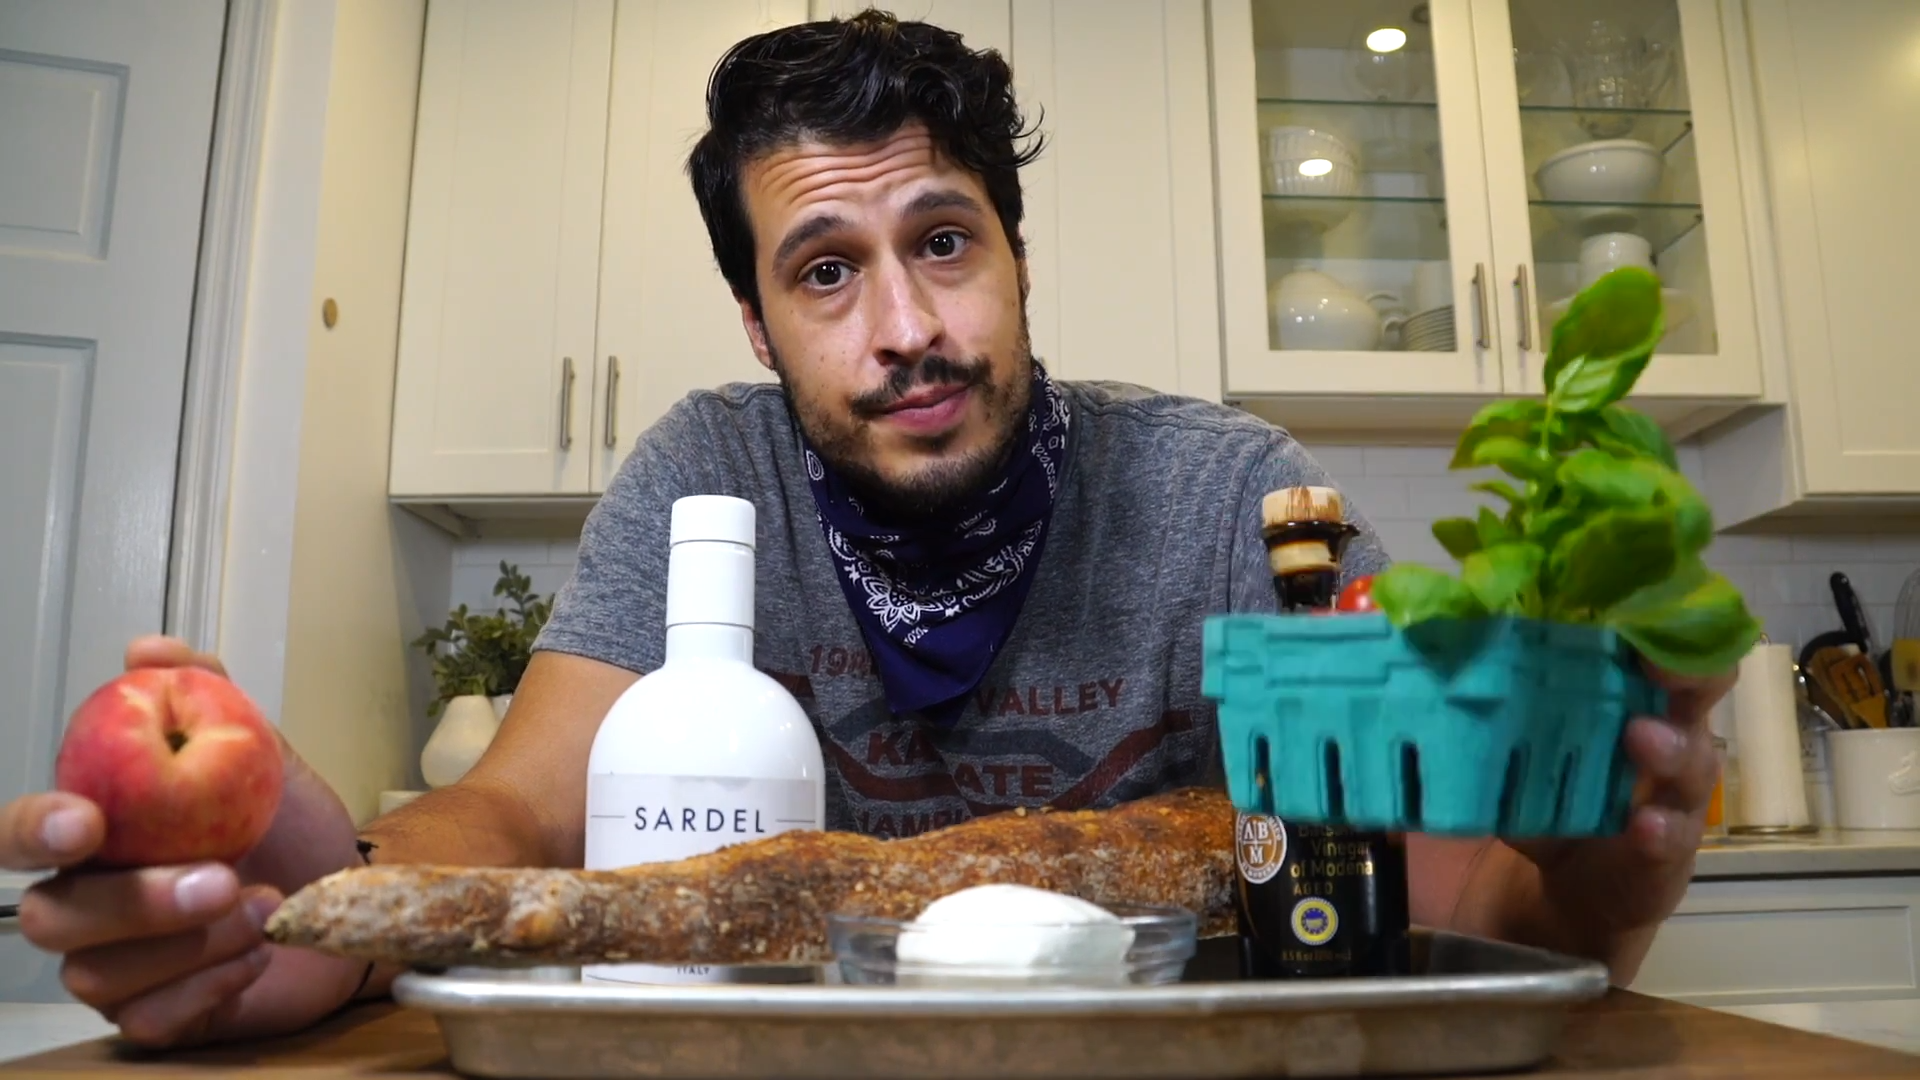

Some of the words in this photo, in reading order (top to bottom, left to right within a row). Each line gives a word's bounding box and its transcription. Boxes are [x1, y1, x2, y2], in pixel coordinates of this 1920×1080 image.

[975, 677, 1126, 718] VALLEY
[866, 729, 1054, 798] KAATE
[634, 806, 766, 833] SARDEL
[1310, 838, 1371, 860] Vinegar
[1290, 859, 1306, 878] of
[1311, 858, 1373, 877] Modena
